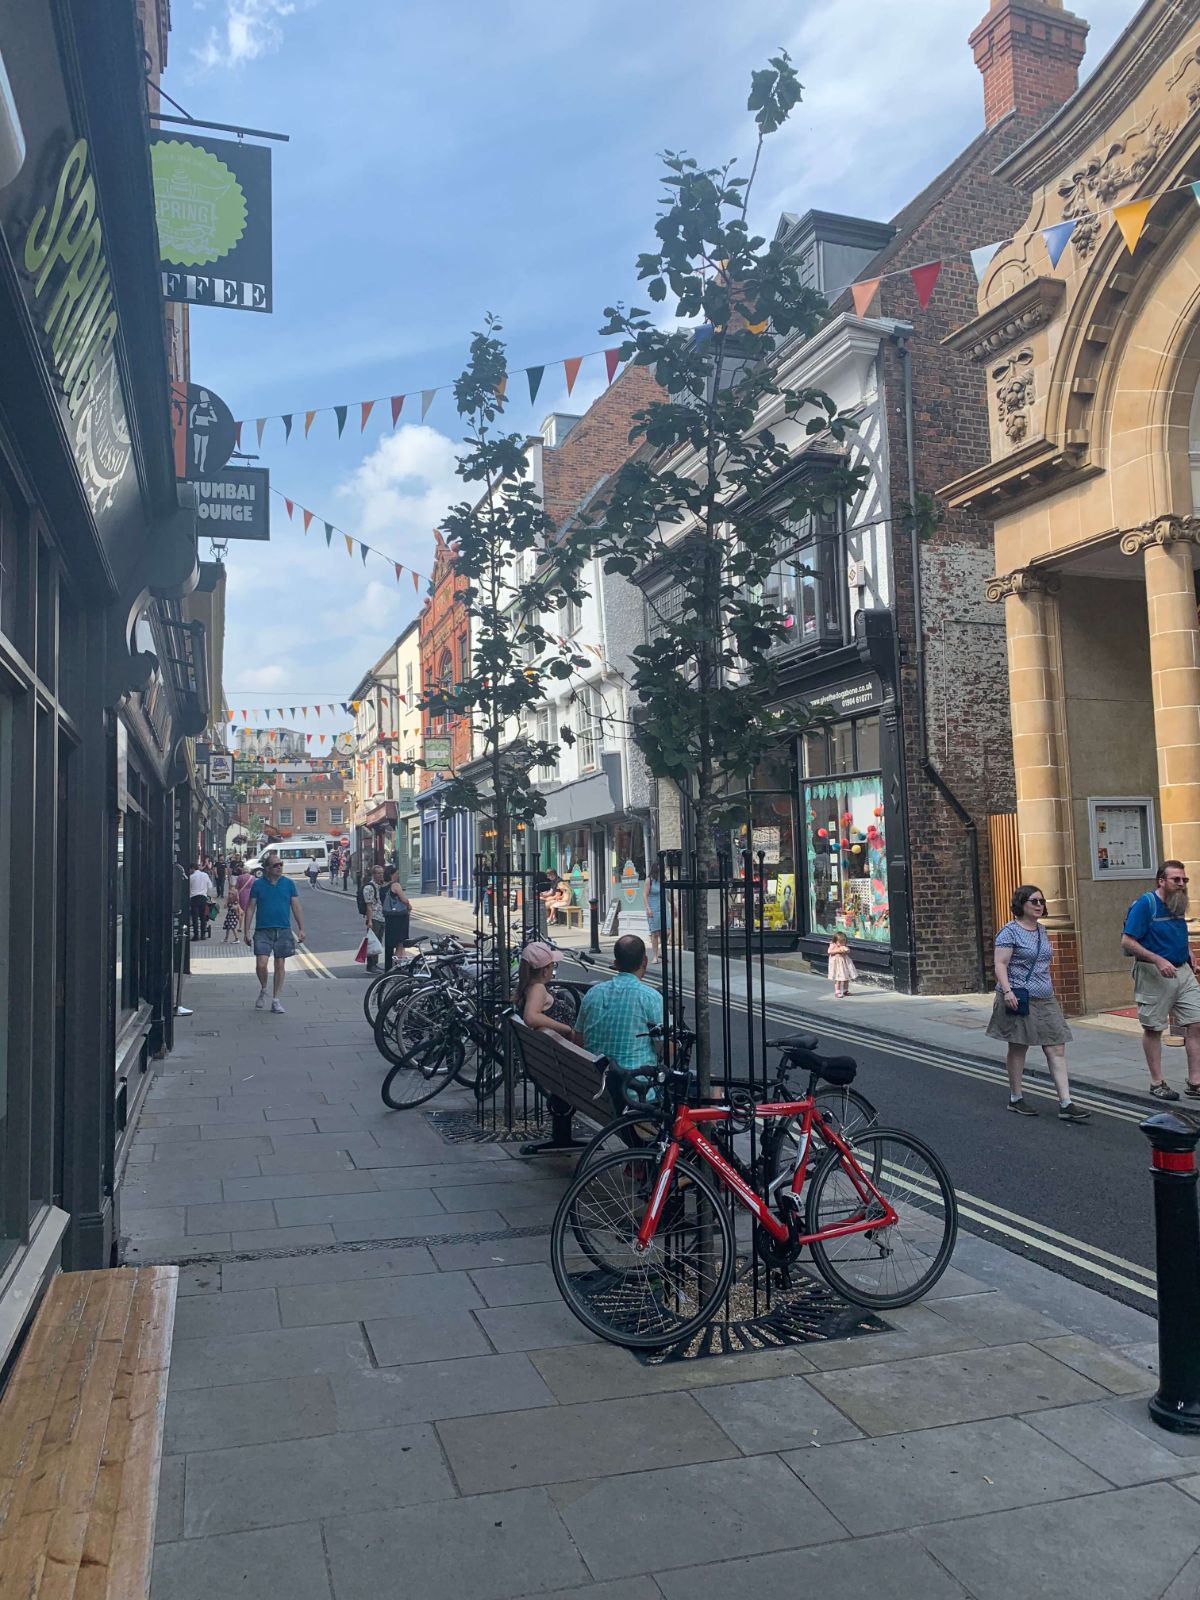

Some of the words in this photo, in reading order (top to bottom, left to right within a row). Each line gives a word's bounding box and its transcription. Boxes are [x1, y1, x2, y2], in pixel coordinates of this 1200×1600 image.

[157, 199, 209, 225] PRING
[25, 138, 118, 419] SPRING
[162, 271, 267, 308] FFEE
[197, 503, 253, 521] OUNGE
